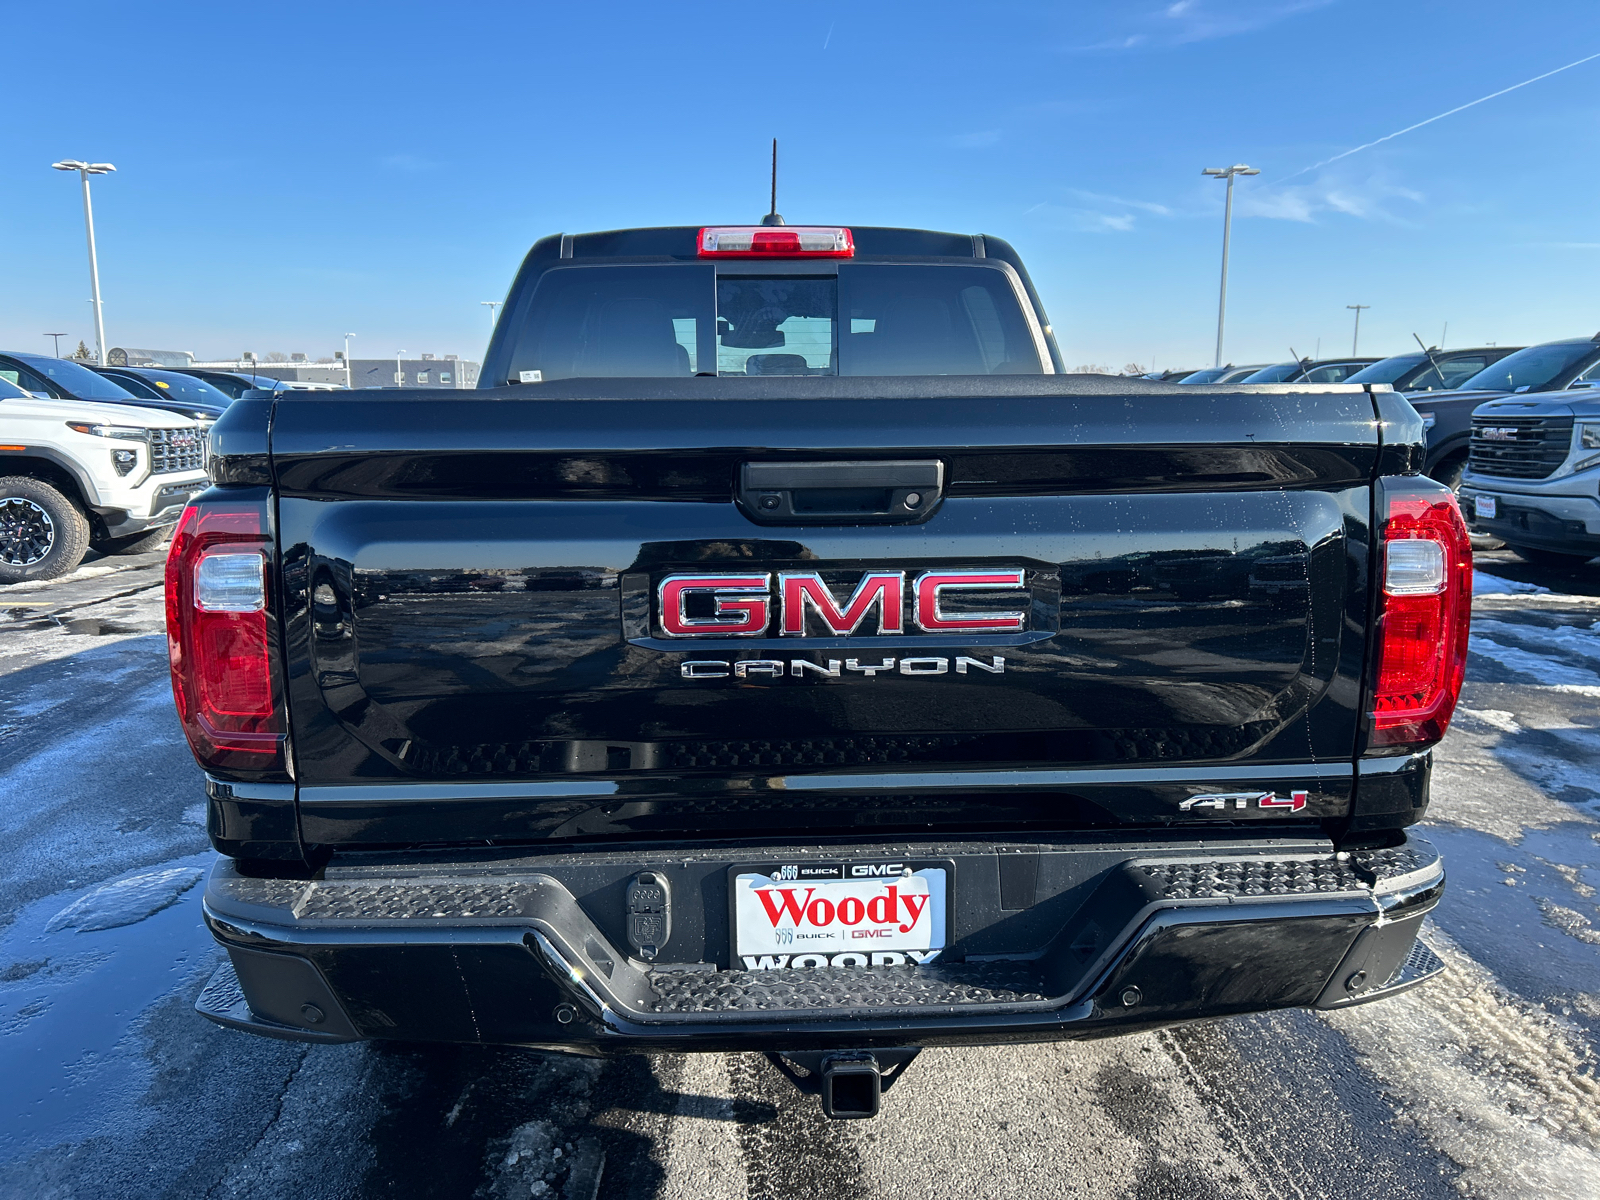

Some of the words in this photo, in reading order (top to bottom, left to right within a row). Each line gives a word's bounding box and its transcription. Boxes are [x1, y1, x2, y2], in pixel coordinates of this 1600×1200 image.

[657, 568, 1026, 637] GMC
[680, 655, 1005, 679] CANYON
[1179, 790, 1309, 812] AT4
[801, 867, 838, 875] BUICK
[851, 864, 904, 876] GMC
[754, 885, 931, 933] Woody
[851, 928, 893, 939] GMC
